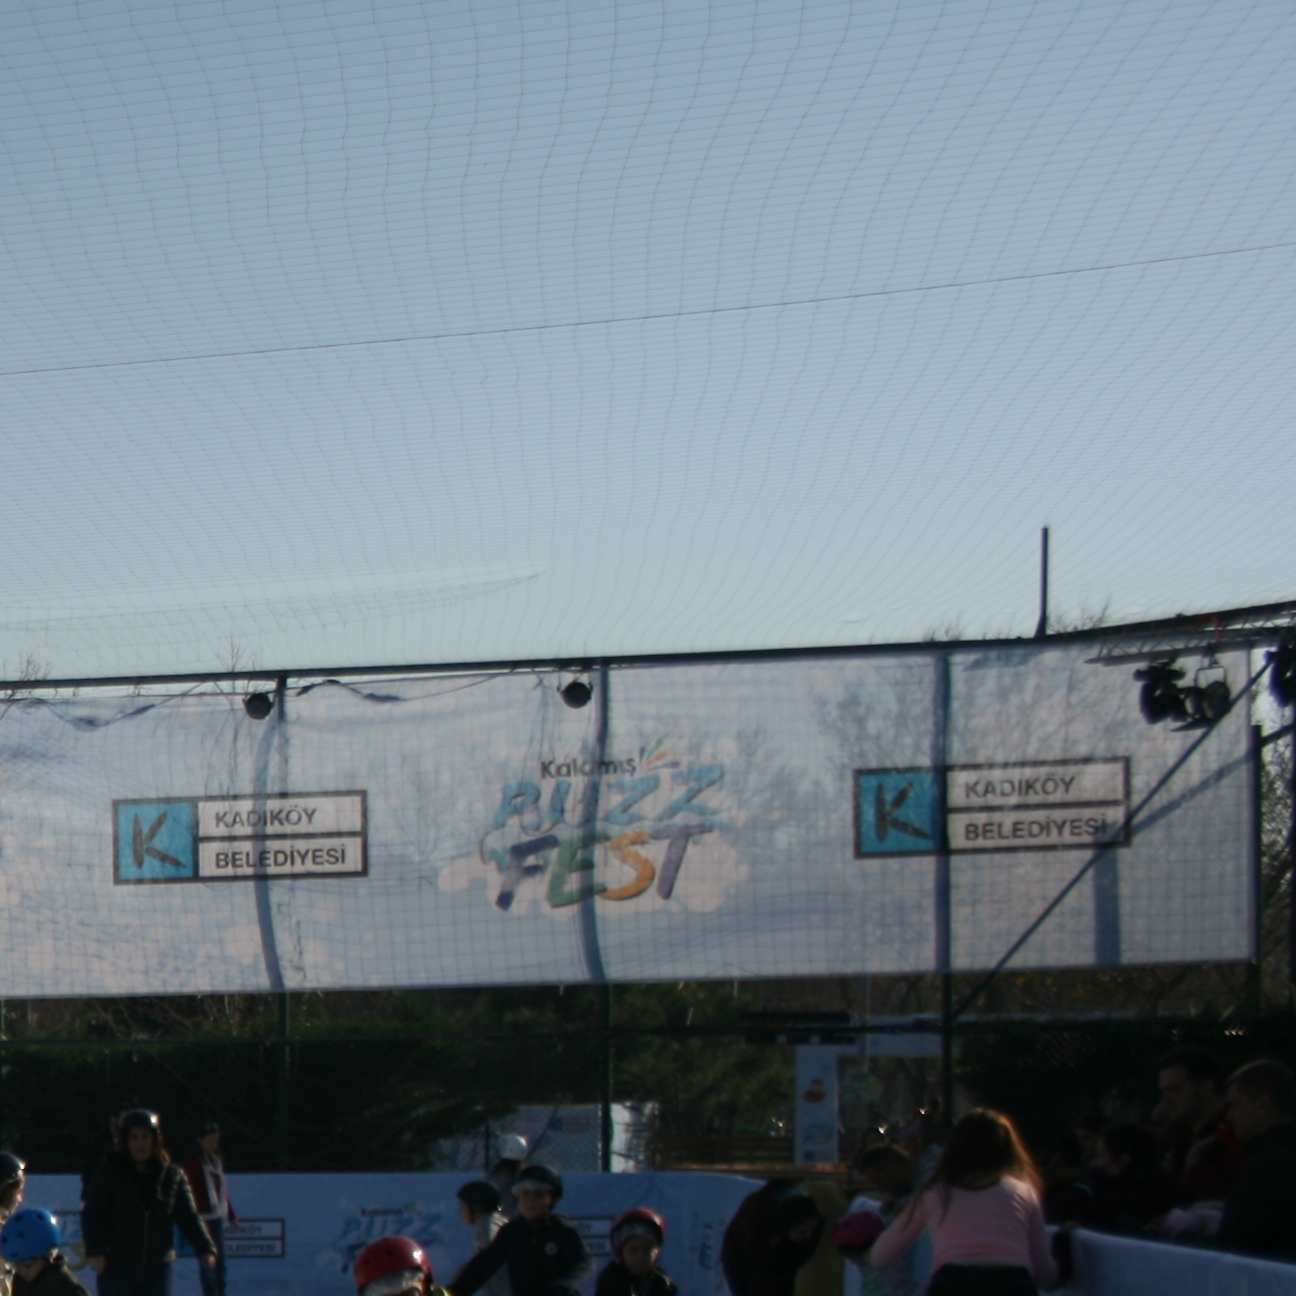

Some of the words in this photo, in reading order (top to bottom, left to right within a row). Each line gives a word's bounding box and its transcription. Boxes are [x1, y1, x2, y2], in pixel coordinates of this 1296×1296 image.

[541, 757, 637, 779] Kalamış
[965, 774, 1075, 799] KADIKÖY
[215, 805, 317, 828] KADIKÖY
[965, 813, 1107, 841] BELEDİYESİ
[215, 844, 346, 869] BELEDİYESİ
[495, 824, 714, 911] FEST
